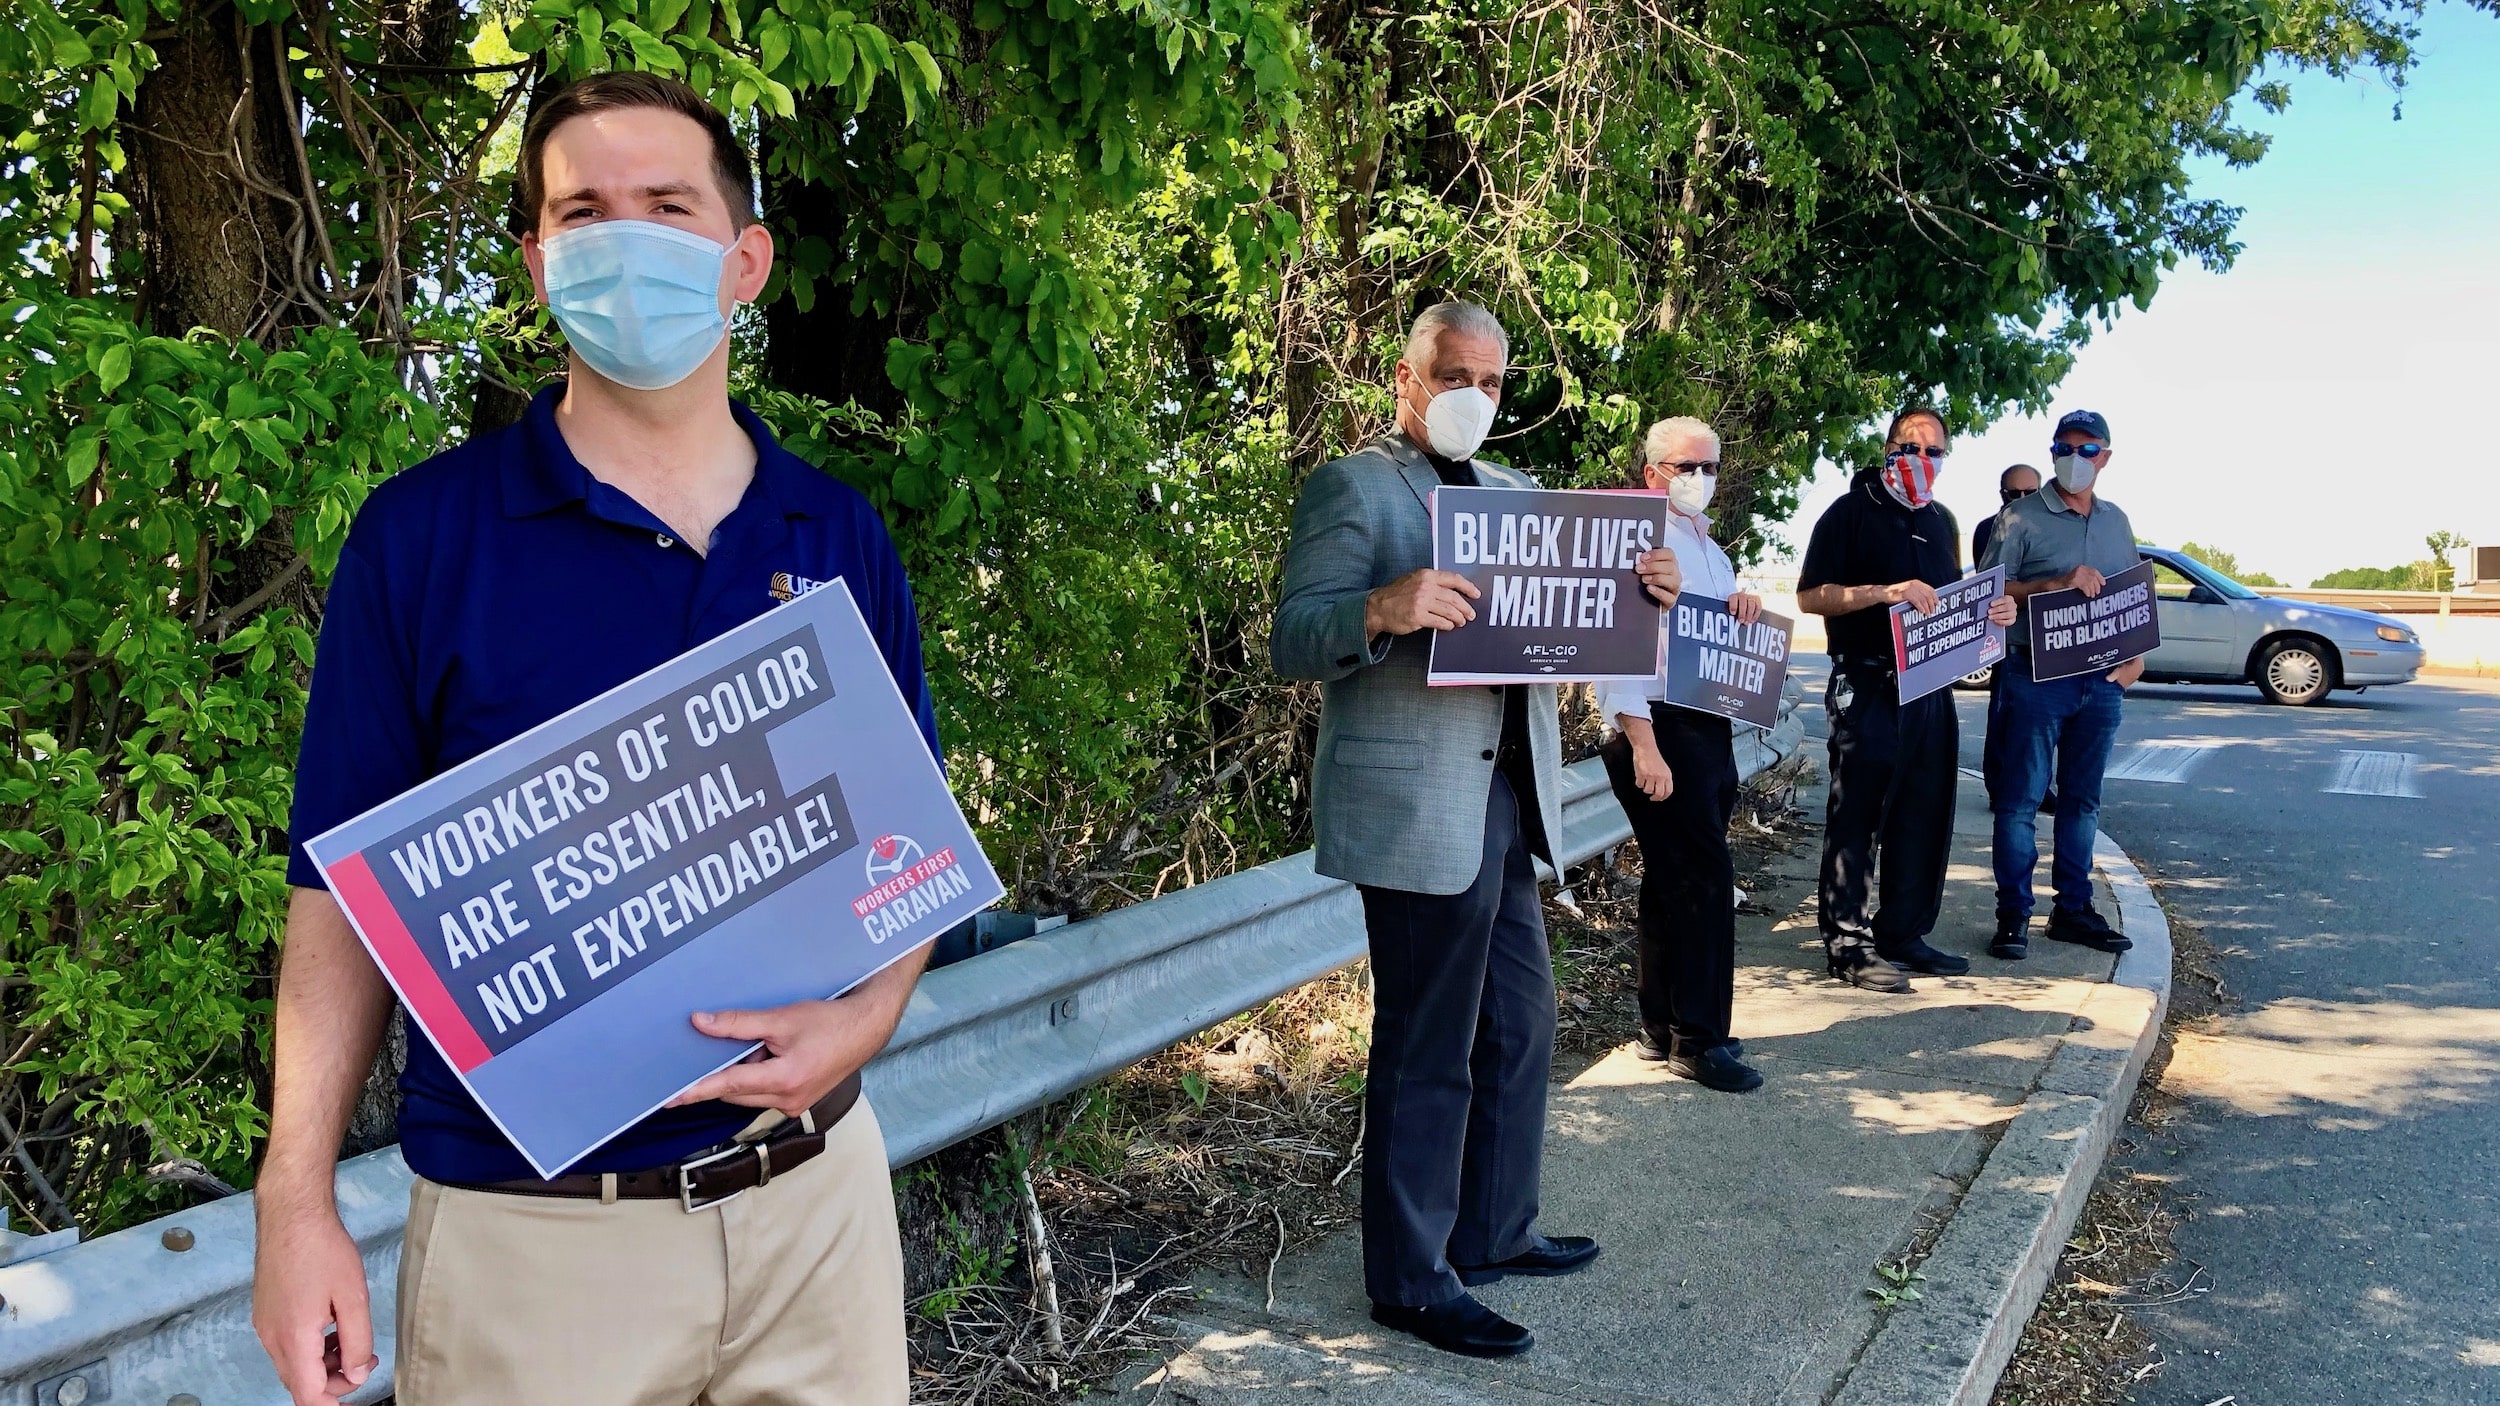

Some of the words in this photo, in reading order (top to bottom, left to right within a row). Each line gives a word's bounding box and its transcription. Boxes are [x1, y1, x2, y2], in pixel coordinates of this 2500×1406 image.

[1453, 512, 1564, 568] BLACK
[1572, 516, 1654, 570] LIVES
[1489, 575, 1617, 629] MATTER
[1902, 597, 1948, 627] WORRS
[1950, 592, 1962, 610] OF
[1964, 580, 1993, 604] COLOR
[2043, 603, 2087, 629] UNION
[2090, 581, 2148, 620] MEMBERS
[1522, 645, 1578, 656] AFL-CIO
[1677, 604, 1740, 649] BLACK
[1744, 621, 1786, 662] LIVES
[1906, 627, 1924, 647] ARE
[1927, 608, 1975, 639] ESSENTIAL,
[1908, 645, 1926, 666] NOT
[1928, 621, 1985, 657] EXPENDABLE!
[2045, 629, 2073, 651] FOR
[2076, 616, 2118, 645] BLACK
[2120, 604, 2150, 632] LIVES
[1698, 646, 1766, 695] MATTER
[2087, 648, 2119, 662] AFL-CIO
[1717, 694, 1744, 707] AFL-CIO
[389, 750, 610, 897] WORKERS
[616, 712, 670, 783] OF
[684, 645, 819, 748] COLOR
[439, 879, 530, 970] ARE
[531, 763, 767, 915] ESSENTIAL,
[854, 871, 916, 916] WORKERS
[915, 848, 953, 880] FIRST
[476, 944, 567, 1034] NOT
[571, 793, 839, 981] EXPENDABLE!
[862, 863, 973, 945] CARAVAN
